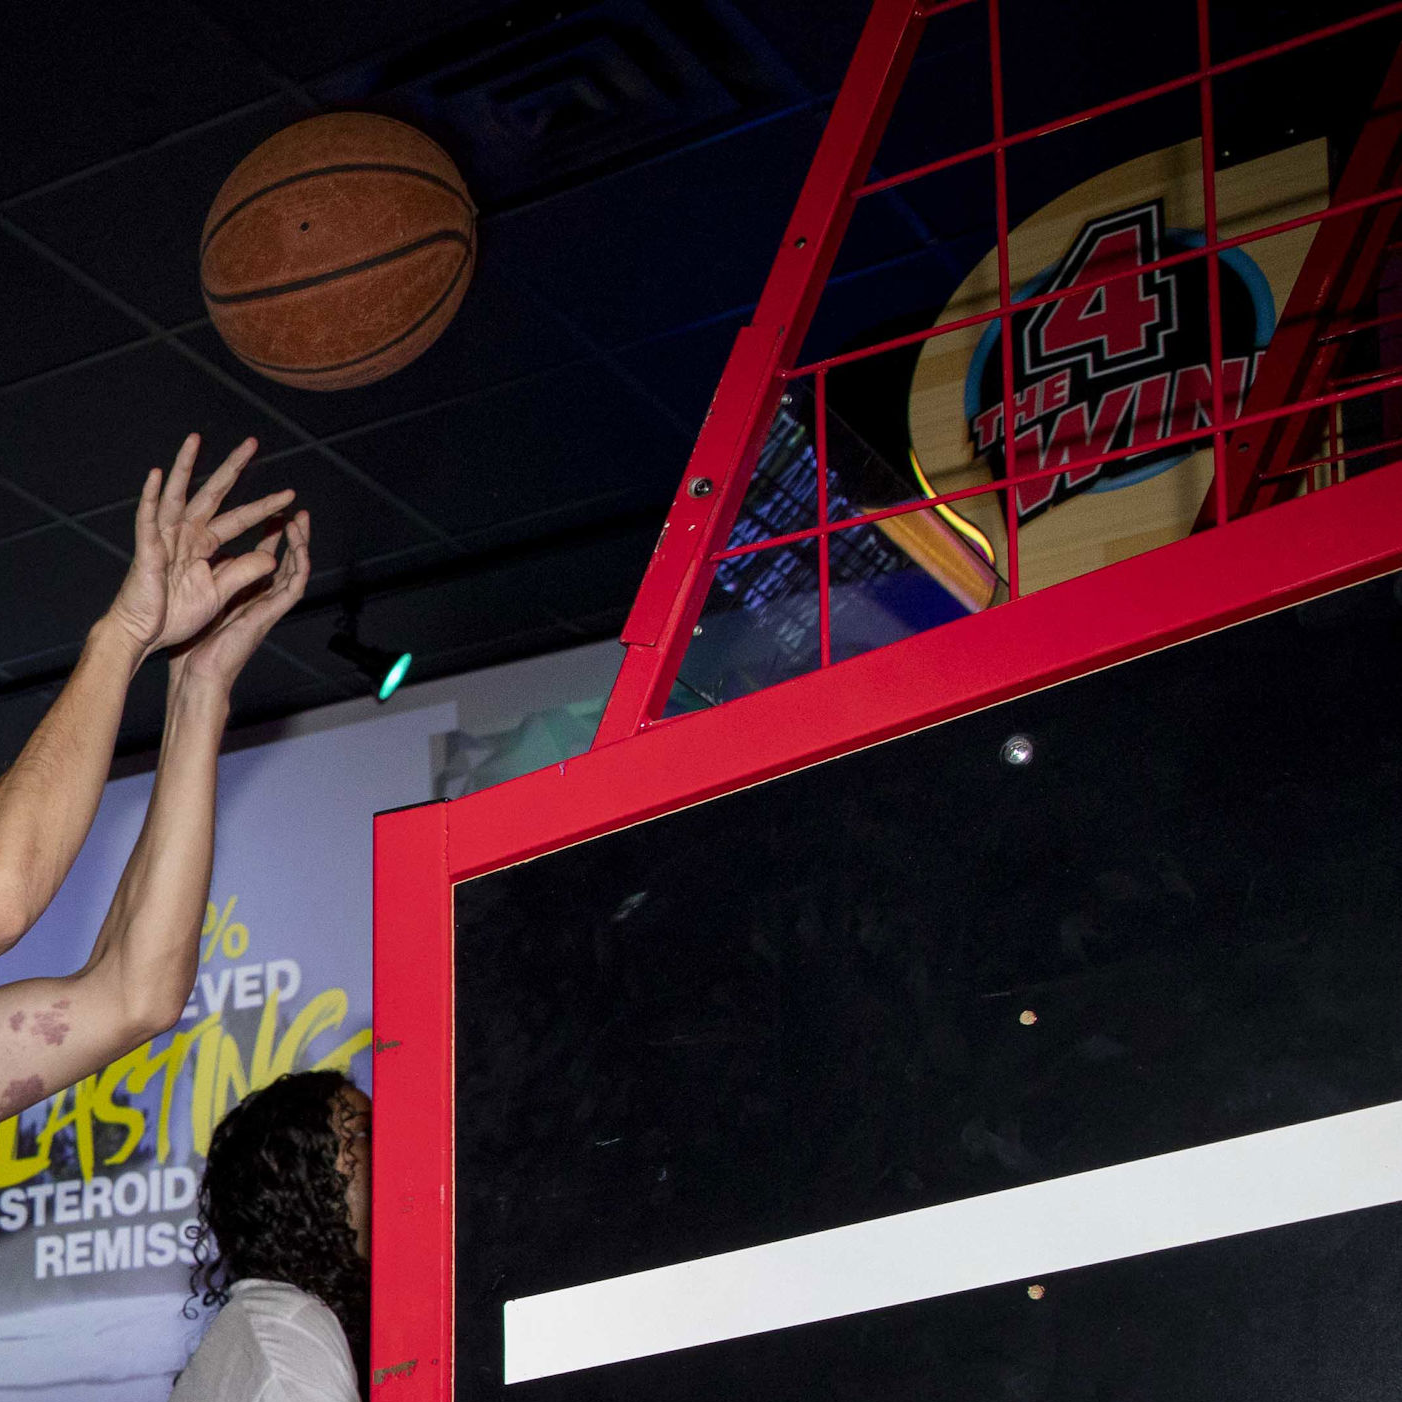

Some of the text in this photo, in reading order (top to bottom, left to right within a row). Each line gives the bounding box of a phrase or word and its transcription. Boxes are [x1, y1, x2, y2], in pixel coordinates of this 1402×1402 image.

[1024, 205, 1178, 379] 4
[973, 368, 1073, 451] THE
[1002, 351, 1268, 519] WIN
